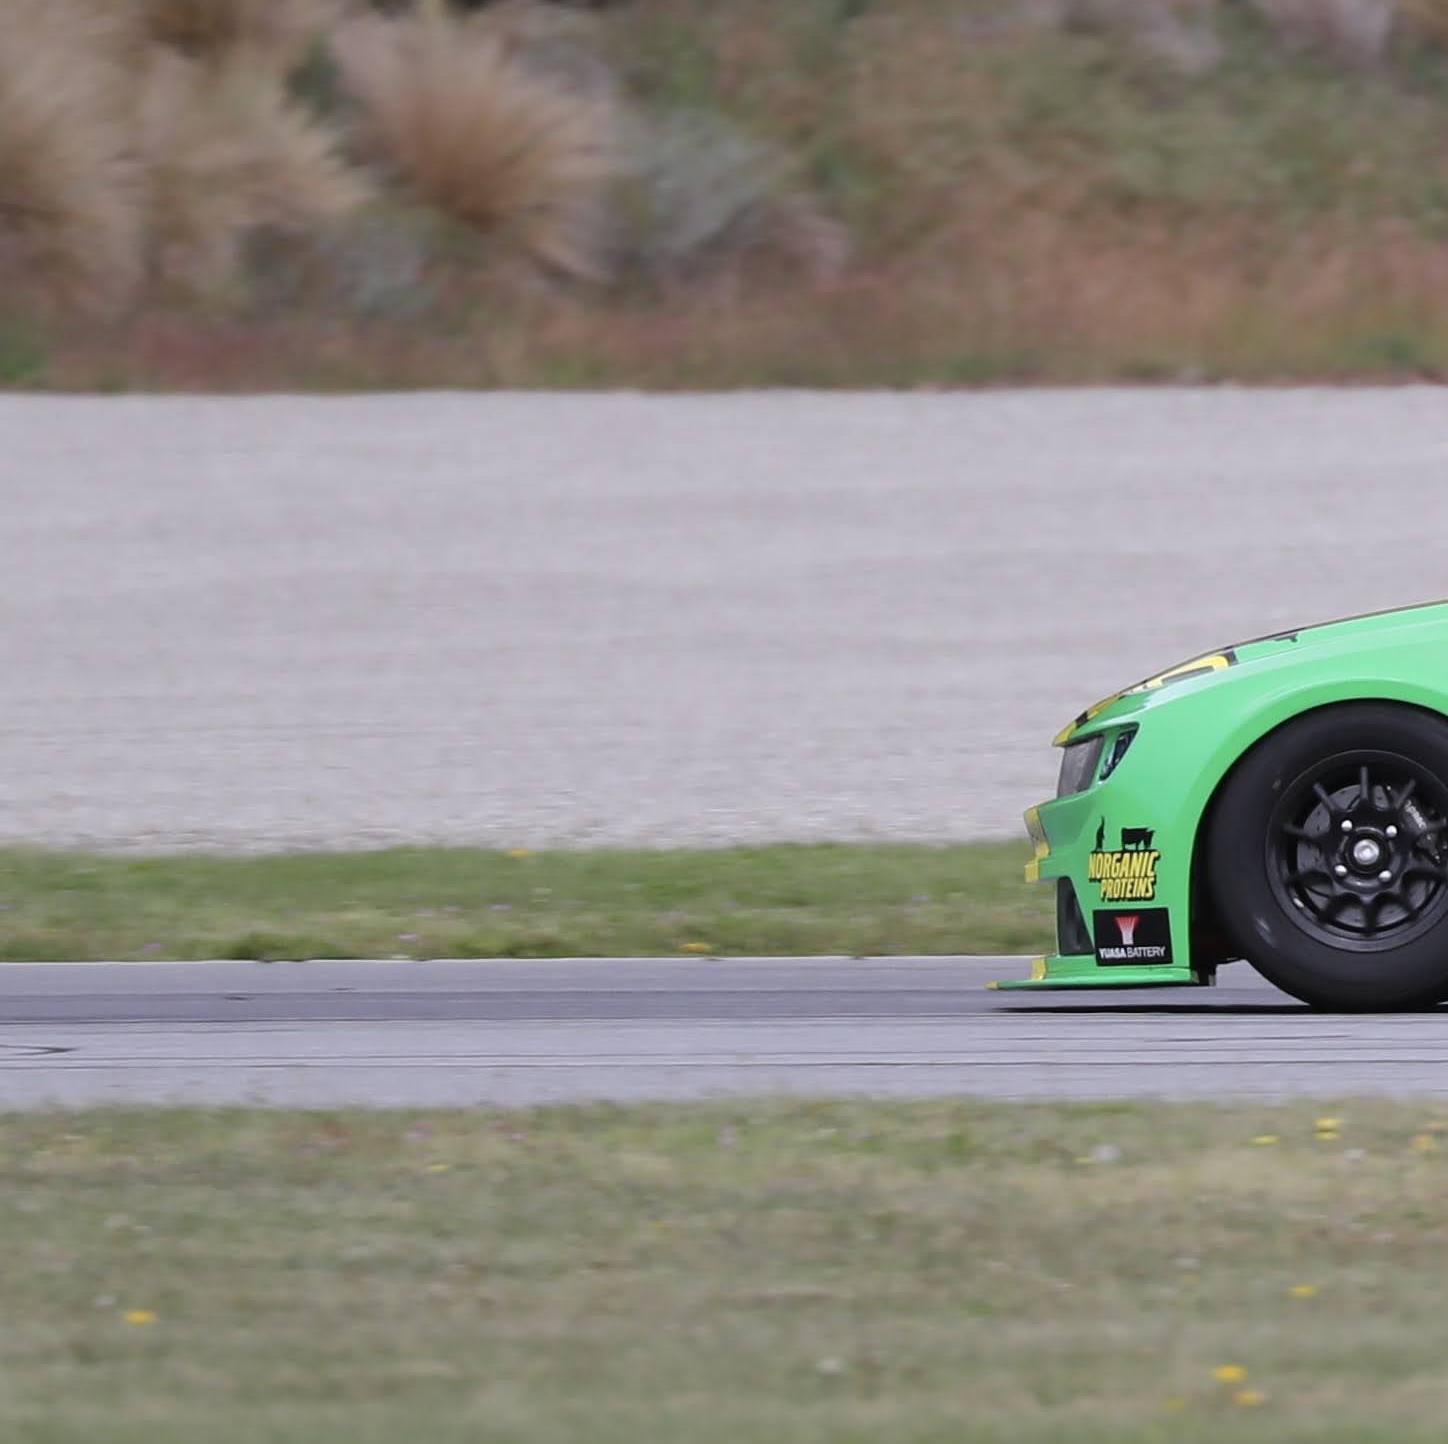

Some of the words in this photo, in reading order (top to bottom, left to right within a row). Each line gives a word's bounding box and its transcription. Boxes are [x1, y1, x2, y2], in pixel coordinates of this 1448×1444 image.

[1088, 852, 1159, 878] NORGANIC
[1101, 877, 1155, 899] PROTEINS
[1099, 947, 1127, 959] YUASA
[1127, 946, 1166, 958] BATTERY
